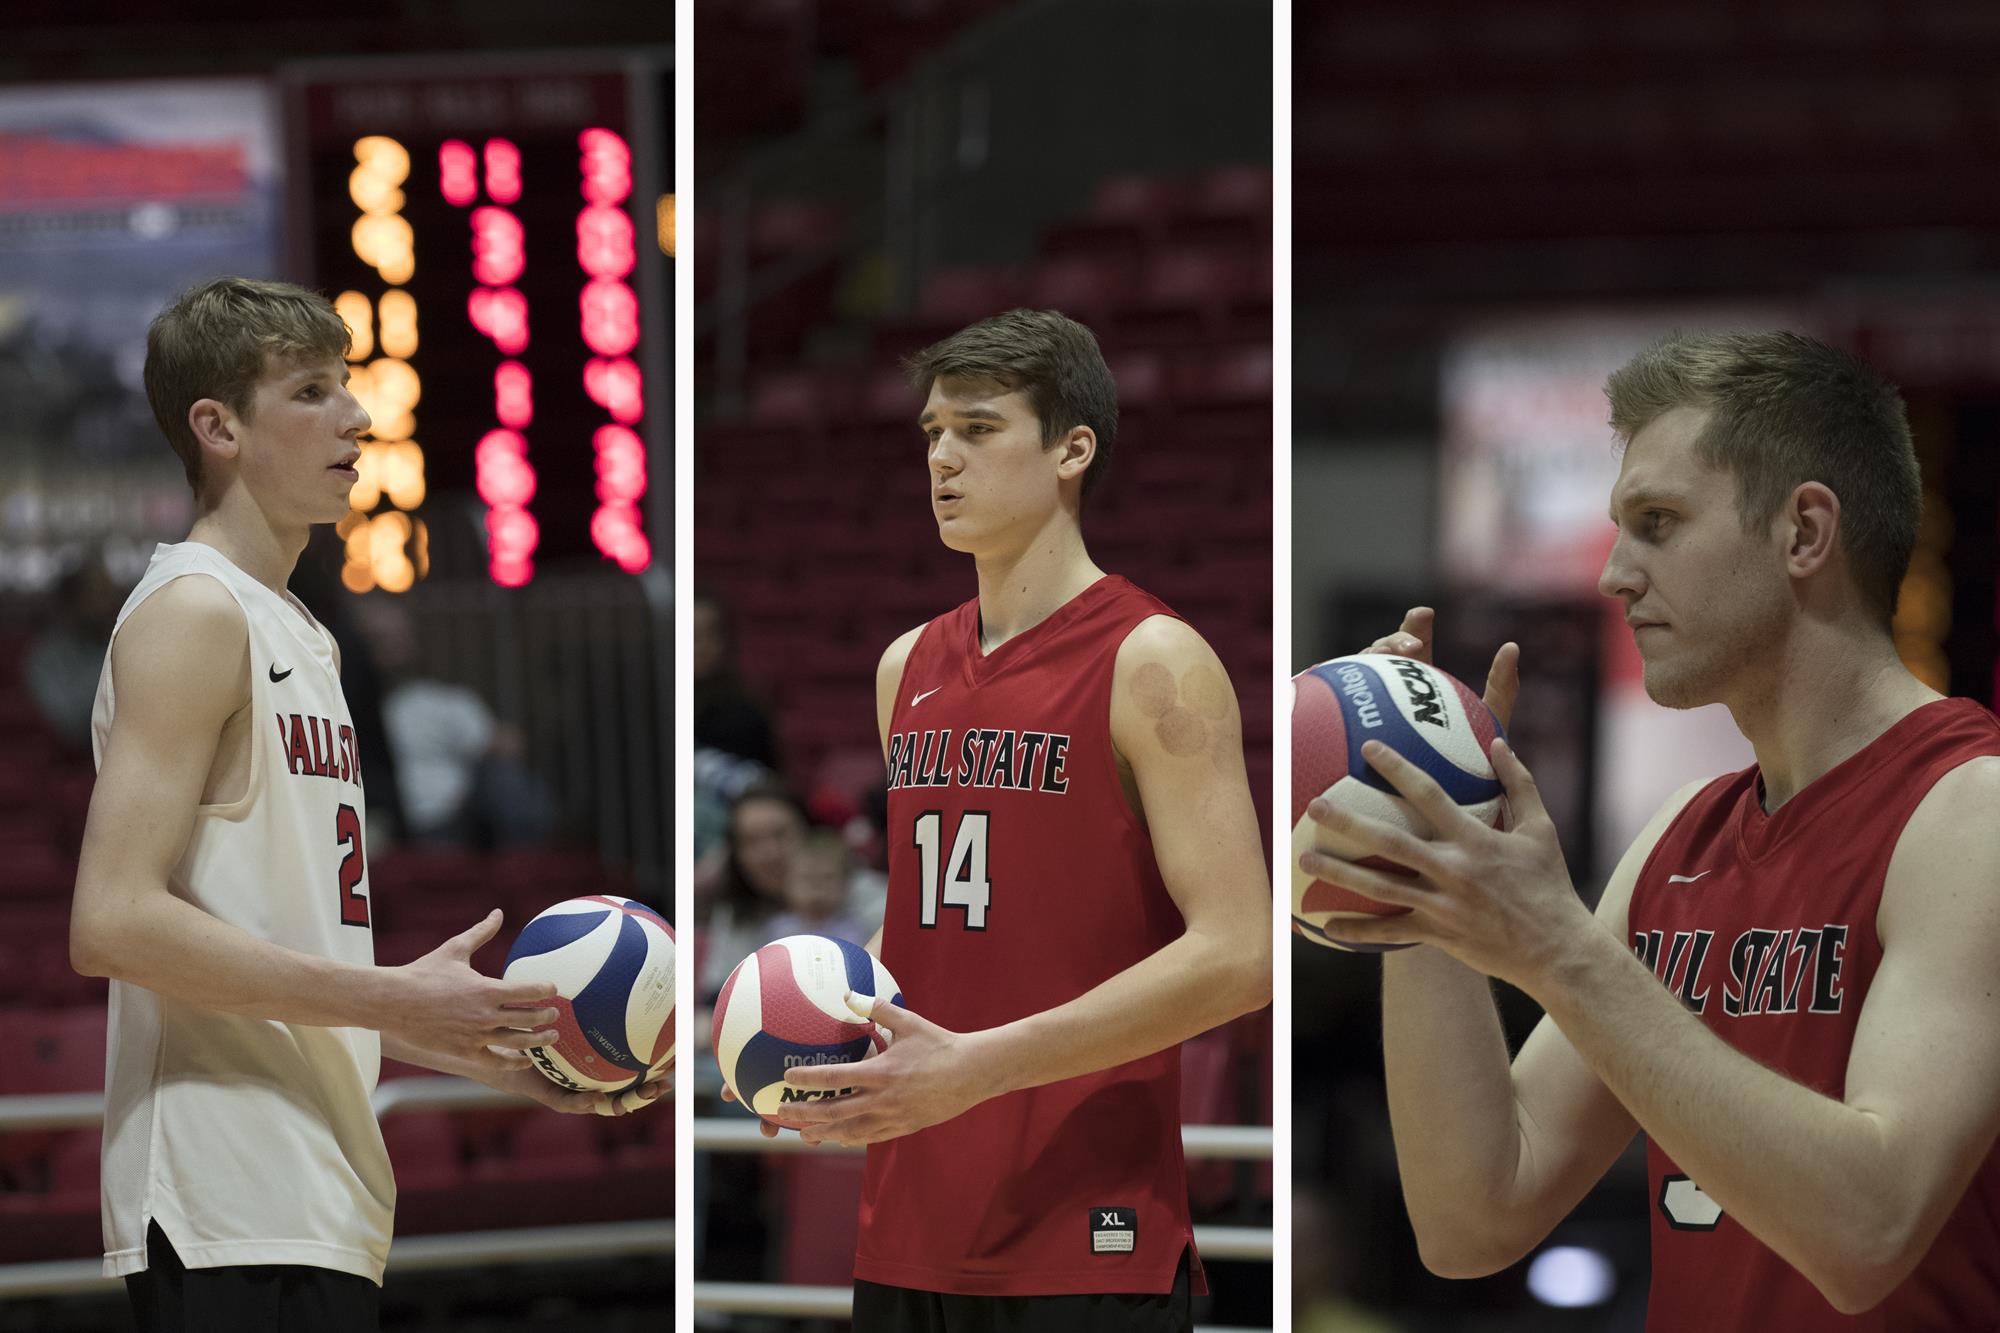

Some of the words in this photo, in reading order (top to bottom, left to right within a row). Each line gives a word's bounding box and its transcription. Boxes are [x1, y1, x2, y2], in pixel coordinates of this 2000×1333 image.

[1336, 664, 1384, 729] molten
[1387, 659, 1446, 729] NCAA
[887, 729, 953, 791] BALL
[958, 728, 1071, 795] STATE
[336, 803, 370, 929] 2
[913, 809, 992, 931] 14
[1723, 924, 1849, 1017] STATE
[1101, 1212, 1126, 1226] XL
